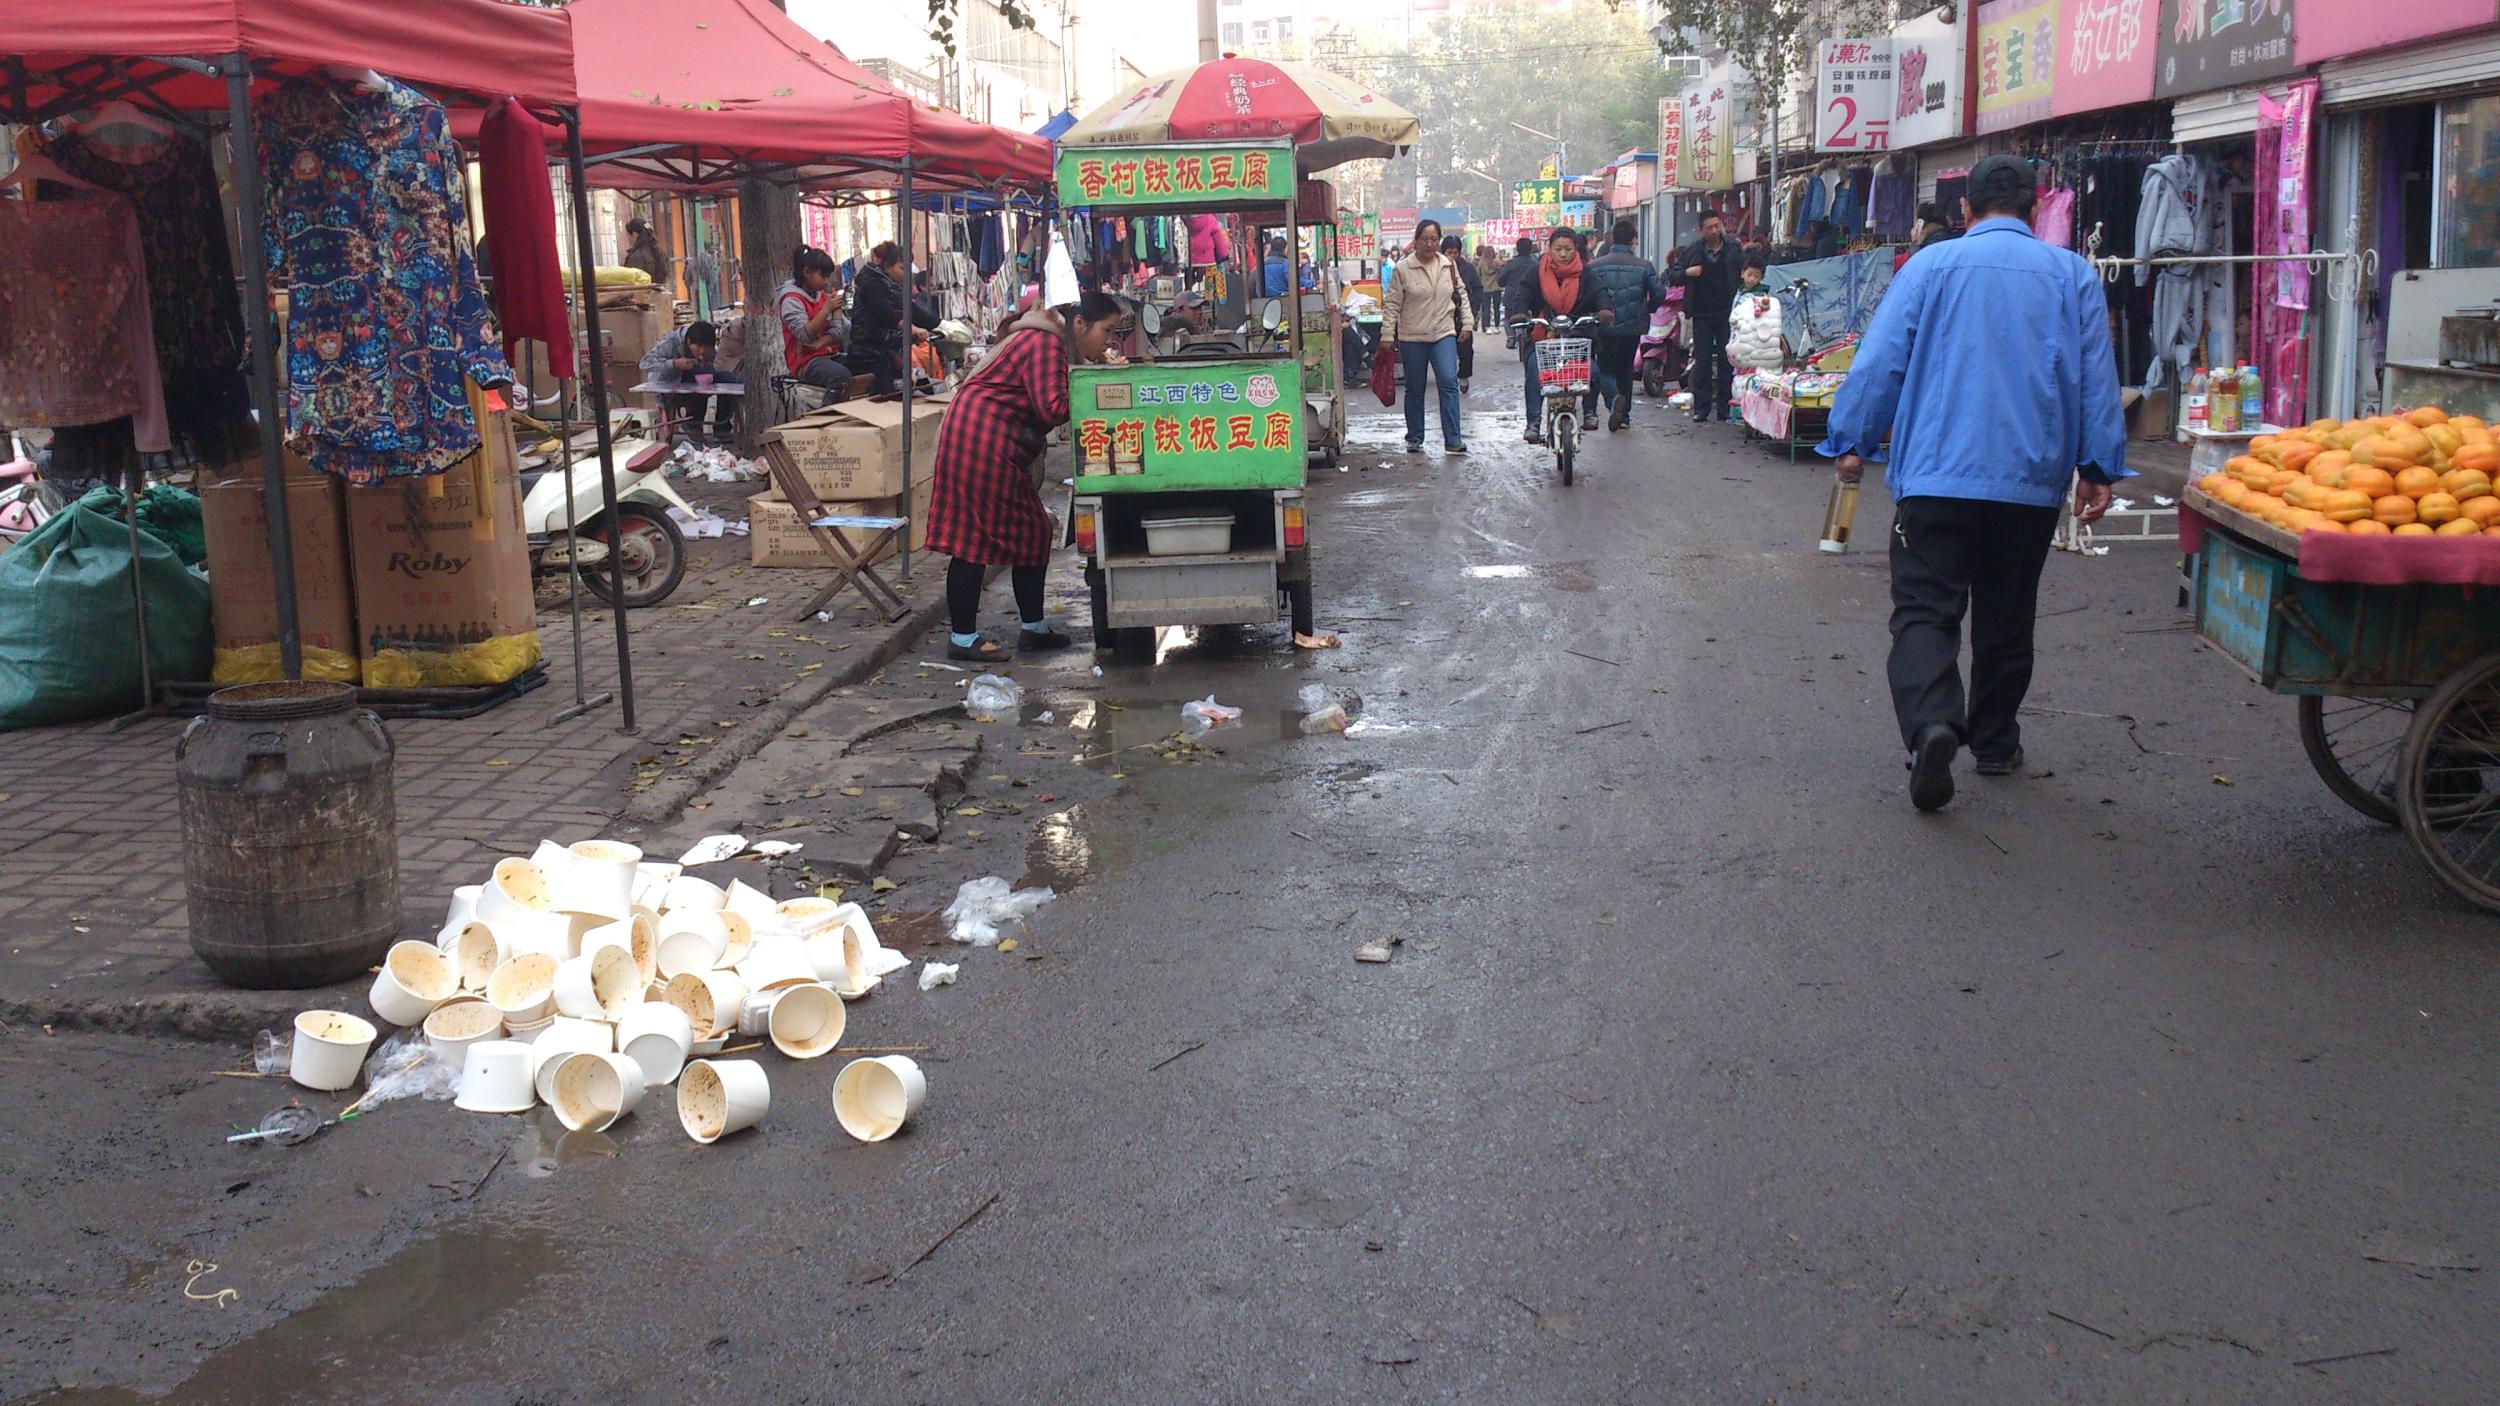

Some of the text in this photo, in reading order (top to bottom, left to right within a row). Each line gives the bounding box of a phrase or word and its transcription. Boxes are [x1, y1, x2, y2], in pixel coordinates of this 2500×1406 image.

[1825, 96, 1889, 149] 2元
[1078, 151, 1269, 199] 香村铁板豆腐
[1521, 187, 1556, 204] 奶茶
[1139, 382, 1239, 404] 江西特色
[1080, 411, 1292, 459] 香村铁板豆腐
[387, 551, 472, 580] Roby
